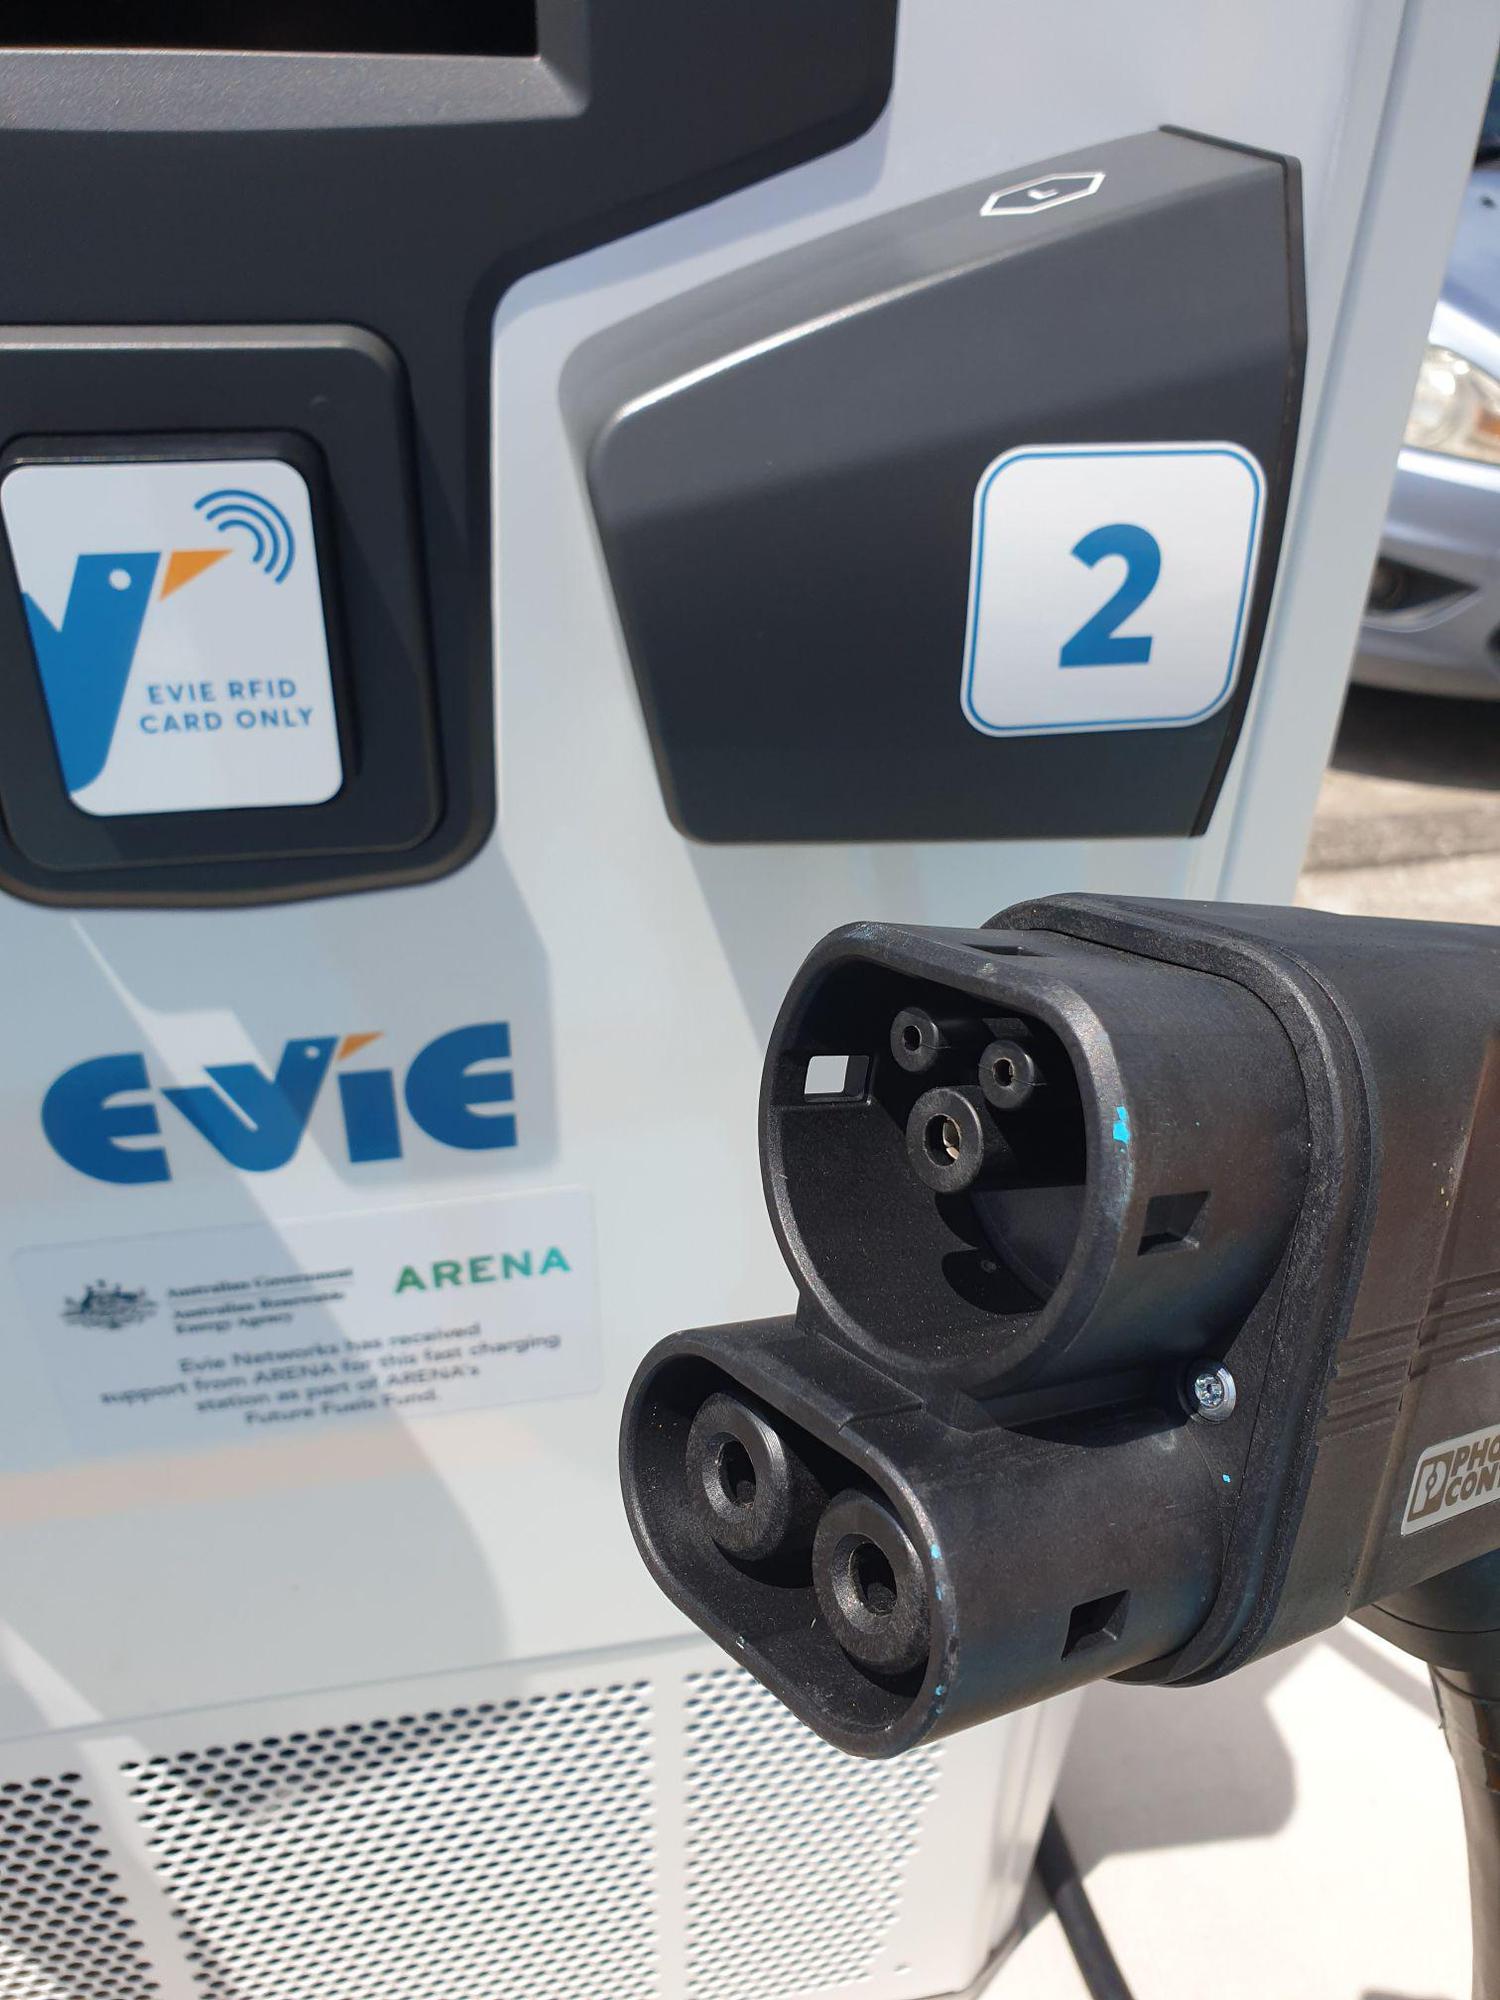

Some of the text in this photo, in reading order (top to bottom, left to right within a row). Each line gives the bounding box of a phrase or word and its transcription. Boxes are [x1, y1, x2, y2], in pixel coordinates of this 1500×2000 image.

[1059, 523, 1161, 668] 2
[147, 678, 297, 704] EVIE RFID
[140, 708, 314, 734] CARD ONLY
[394, 1246, 571, 1294] ARENA
[100, 1381, 187, 1406] support
[194, 1376, 246, 1392] from
[255, 1361, 335, 1385] ARENA
[340, 1360, 370, 1372] for
[423, 1347, 461, 1362] fast
[470, 1334, 562, 1355] charging
[178, 1322, 481, 1373] Evie Networks has received
[197, 1394, 269, 1412] station
[277, 1390, 299, 1401] as
[306, 1382, 349, 1400] part
[354, 1376, 378, 1391] of
[246, 1407, 314, 1425] Future
[320, 1400, 375, 1415] Fuels
[1445, 1461, 1500, 1506] CON
